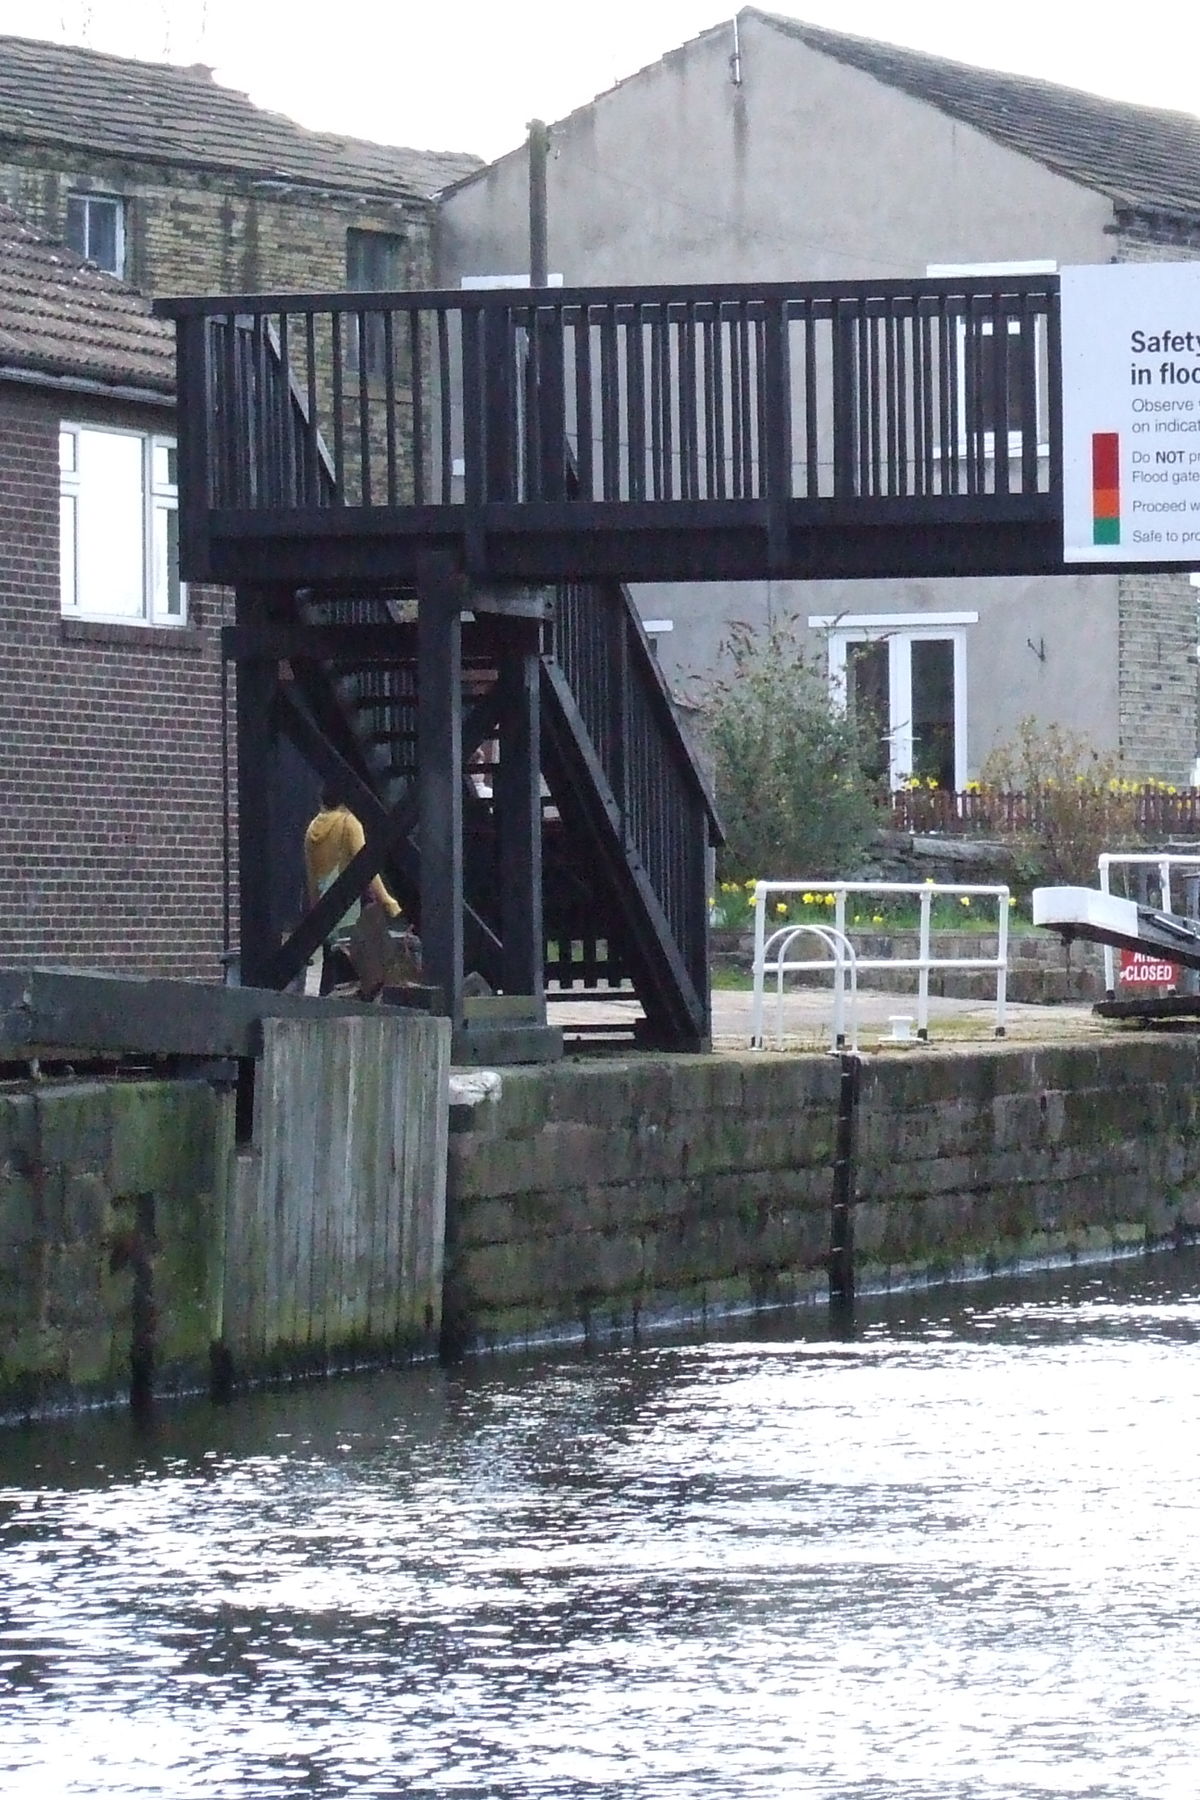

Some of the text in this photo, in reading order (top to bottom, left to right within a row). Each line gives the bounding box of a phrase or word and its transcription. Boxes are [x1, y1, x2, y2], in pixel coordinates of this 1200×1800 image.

[1130, 362, 1152, 386] in
[1131, 398, 1194, 413] Observe
[1131, 422, 1151, 434] on
[1131, 450, 1151, 464] Do
[1155, 450, 1186, 465] NOT
[1131, 470, 1169, 483] Flood
[1132, 499, 1187, 513] Proceed
[1132, 529, 1163, 544] Safe
[1165, 530, 1179, 543] to
[1126, 965, 1172, 981] CLOSED
